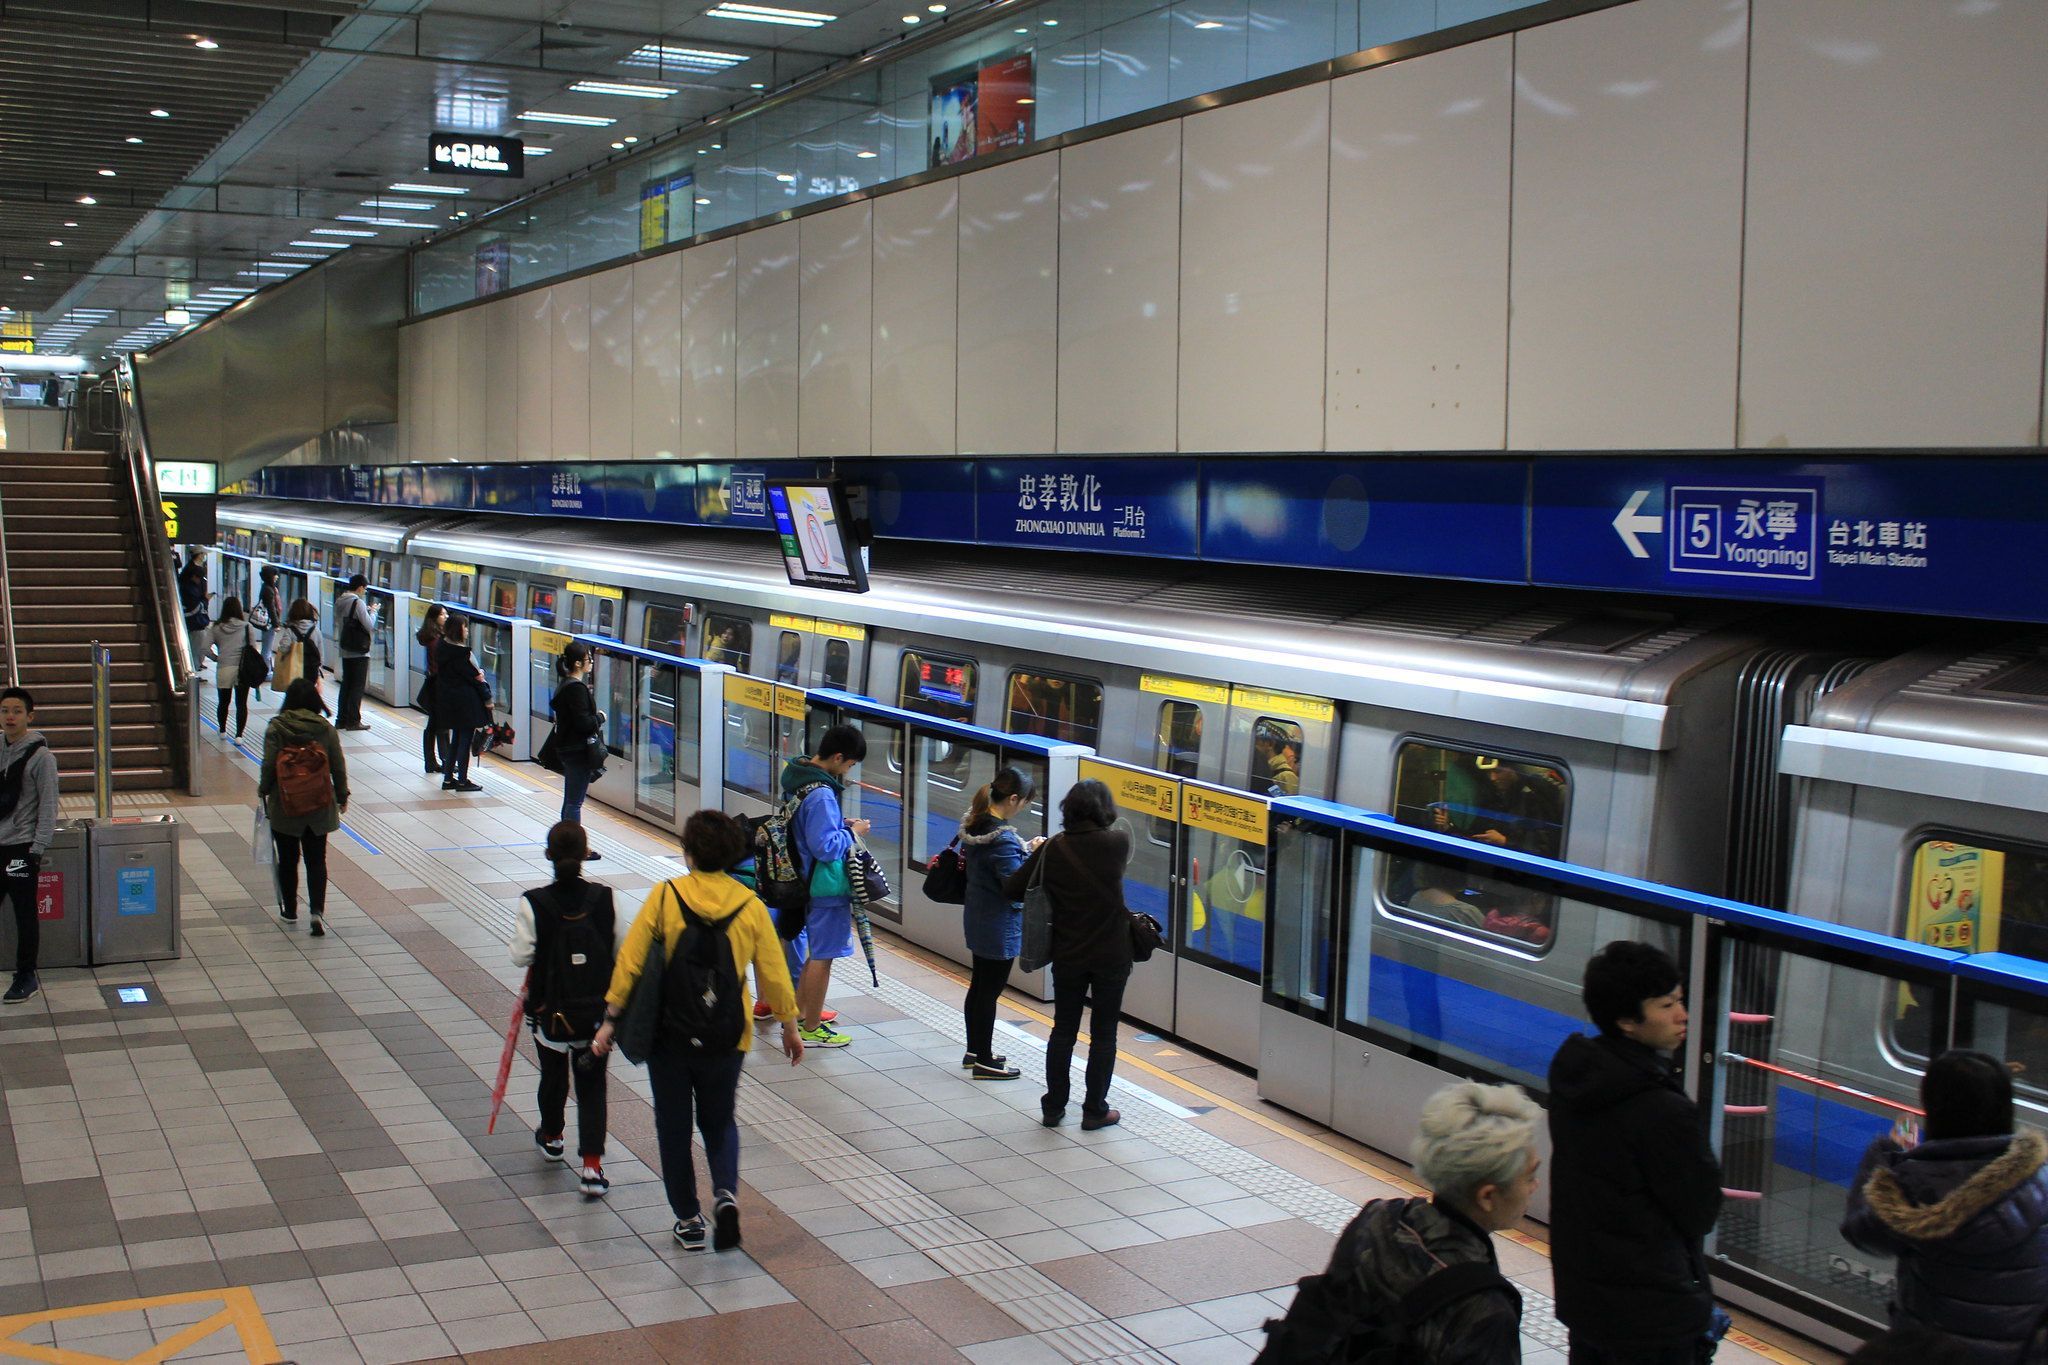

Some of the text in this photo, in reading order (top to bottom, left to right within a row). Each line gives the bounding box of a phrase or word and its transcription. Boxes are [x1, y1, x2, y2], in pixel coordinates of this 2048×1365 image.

[552, 473, 581, 495] 忠孝敦化
[1018, 474, 1102, 512] 忠孝敦化
[735, 488, 743, 503] 5
[1113, 505, 1146, 527] 二月台
[1734, 499, 1799, 542] 永寧
[1015, 519, 1106, 537] ZHONGXIAO DUNHUA
[1113, 526, 1146, 539] Platform 2
[1690, 513, 1711, 549] 5
[1827, 520, 1928, 550] 台北車站
[1724, 542, 1808, 571] Yongning
[1827, 550, 1928, 568] Taipei Main Station
[10, 859, 25, 868] NIKE
[1735, 1336, 1769, 1351] gap
